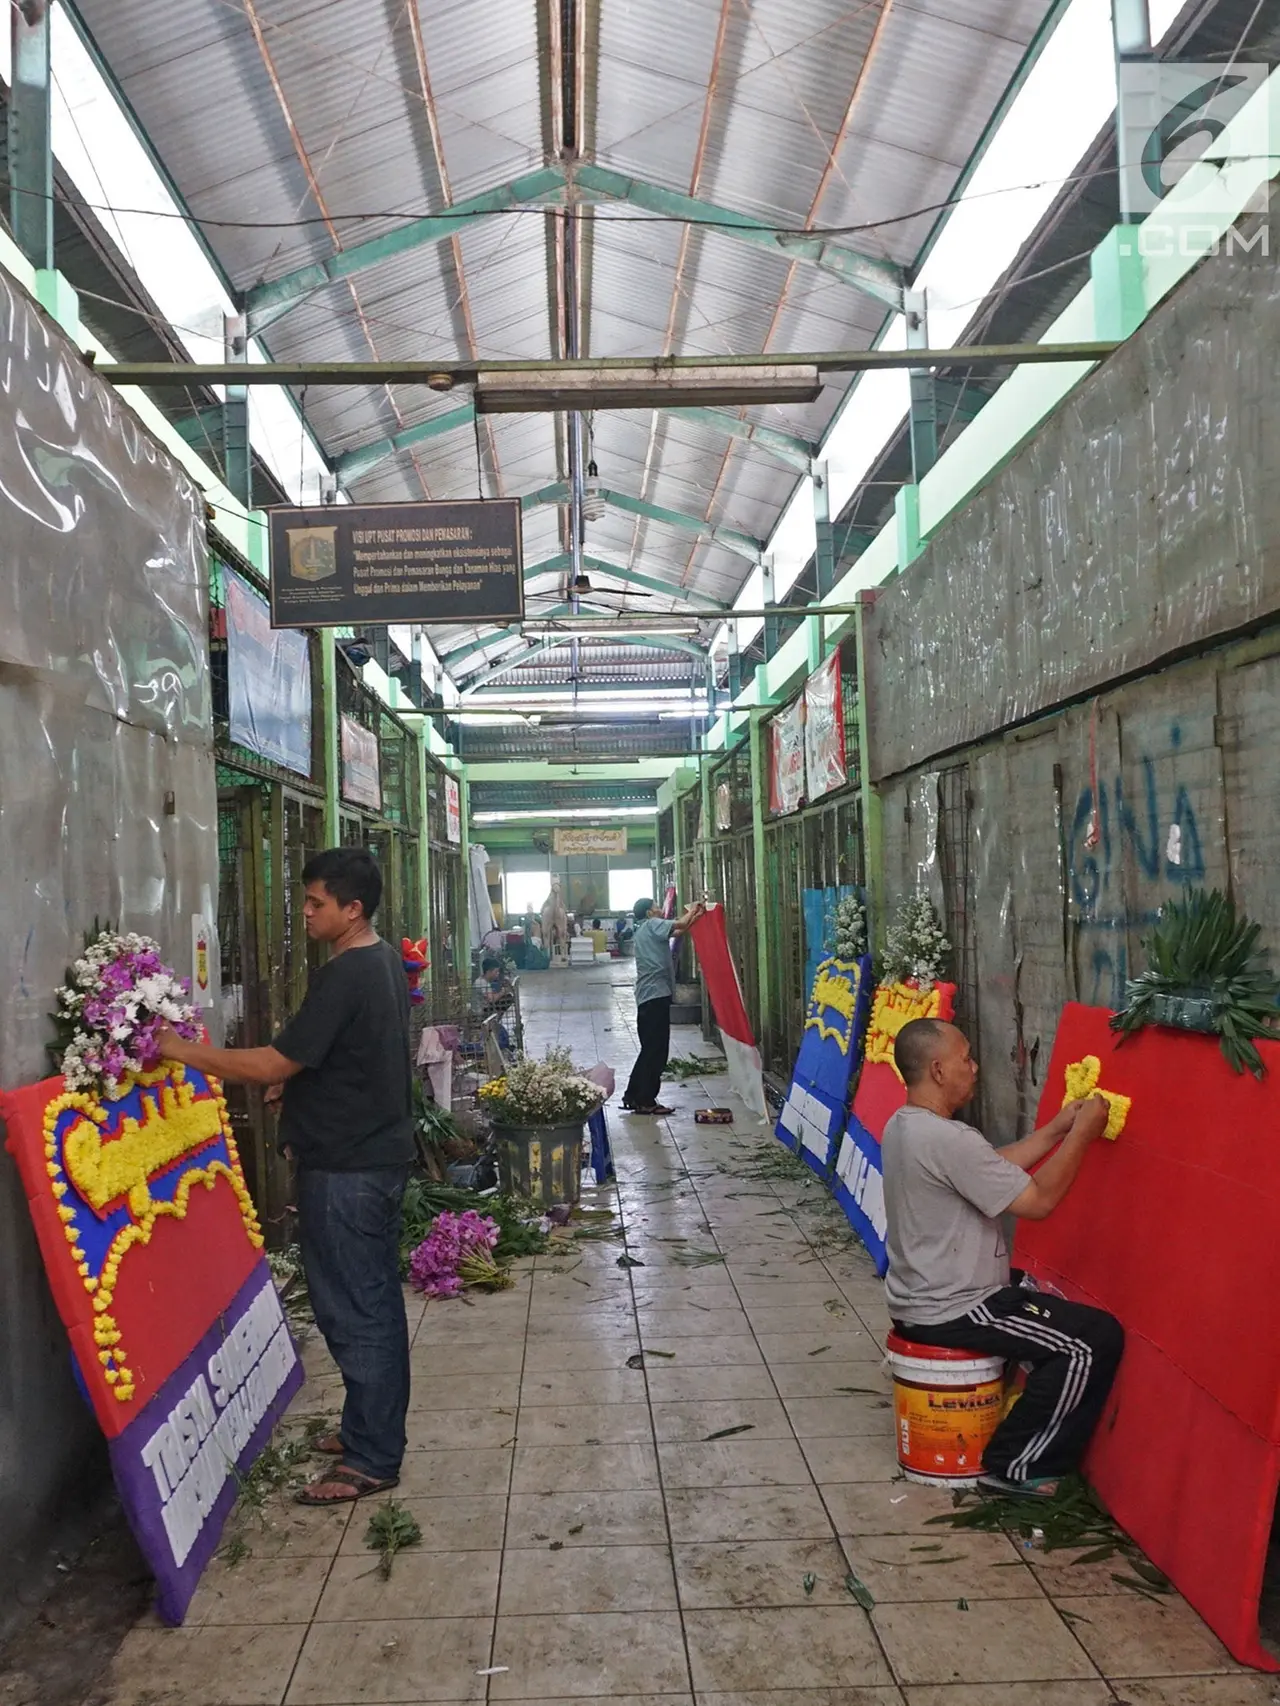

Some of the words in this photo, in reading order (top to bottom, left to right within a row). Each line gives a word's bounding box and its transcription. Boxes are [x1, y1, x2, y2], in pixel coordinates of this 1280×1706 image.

[377, 529, 395, 543] PUSAT
[396, 528, 421, 542] PROMOSI
[422, 528, 434, 541] DAN
[370, 565, 392, 577] Promosi
[393, 565, 403, 576] dan
[404, 564, 434, 576] Pemasaran
[435, 563, 452, 577] Bunga
[453, 564, 464, 574] dan
[502, 563, 516, 575] yang
[384, 582, 401, 593] Prima
